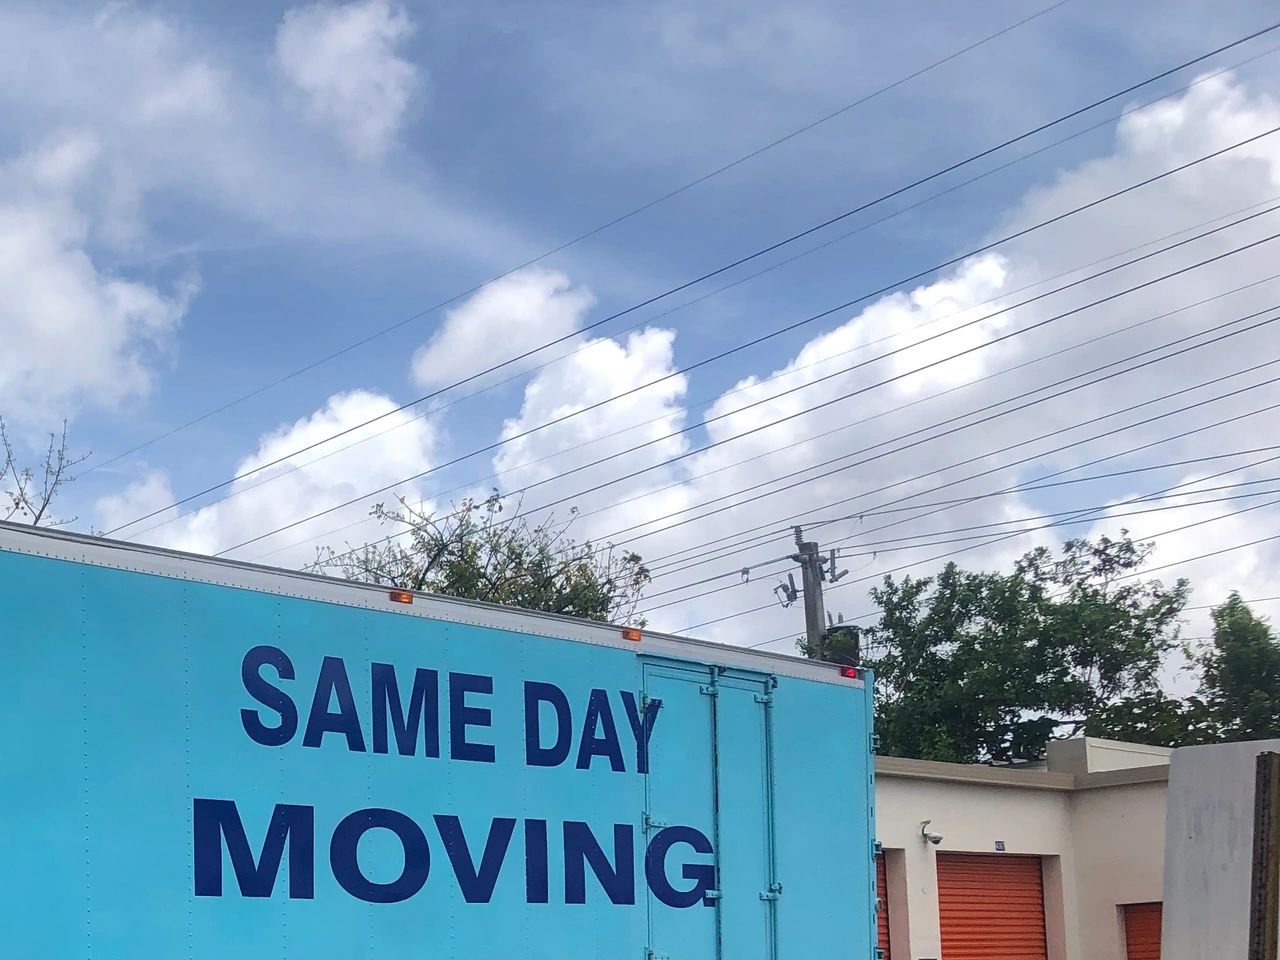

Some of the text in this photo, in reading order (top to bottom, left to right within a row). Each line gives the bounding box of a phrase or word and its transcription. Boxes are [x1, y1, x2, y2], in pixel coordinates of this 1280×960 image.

[240, 645, 662, 774] SAME DAY
[193, 797, 717, 908] MOVING
